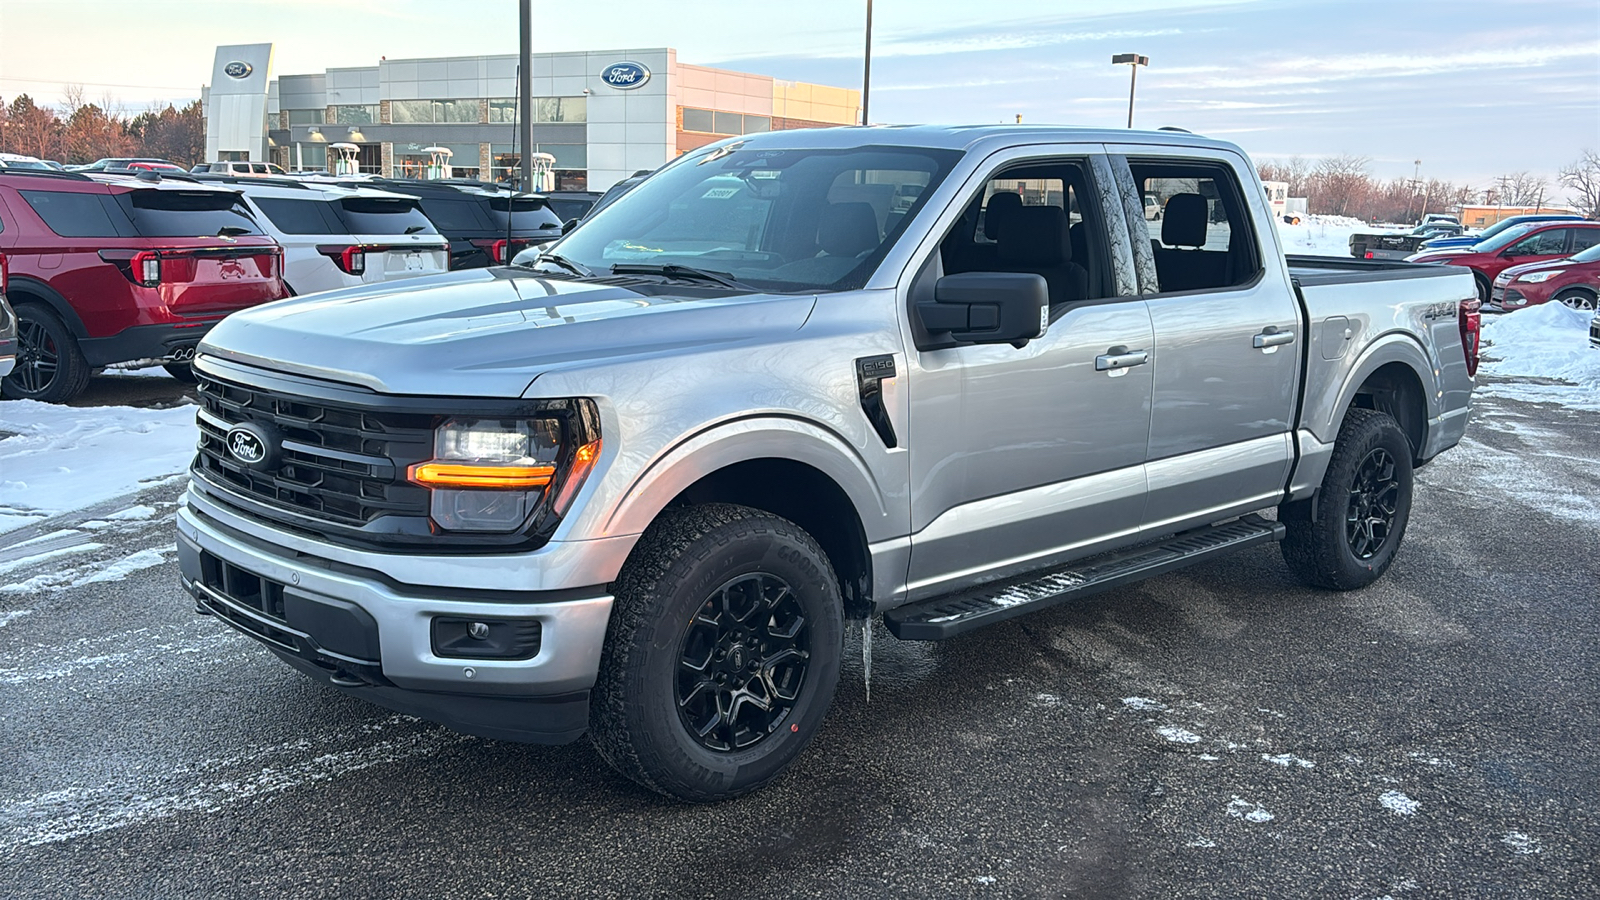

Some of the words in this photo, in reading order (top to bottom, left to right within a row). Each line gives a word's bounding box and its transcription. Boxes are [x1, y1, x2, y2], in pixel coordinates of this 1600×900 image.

[608, 67, 636, 83] Ford
[863, 360, 894, 370] F-150
[232, 432, 257, 459] Ford
